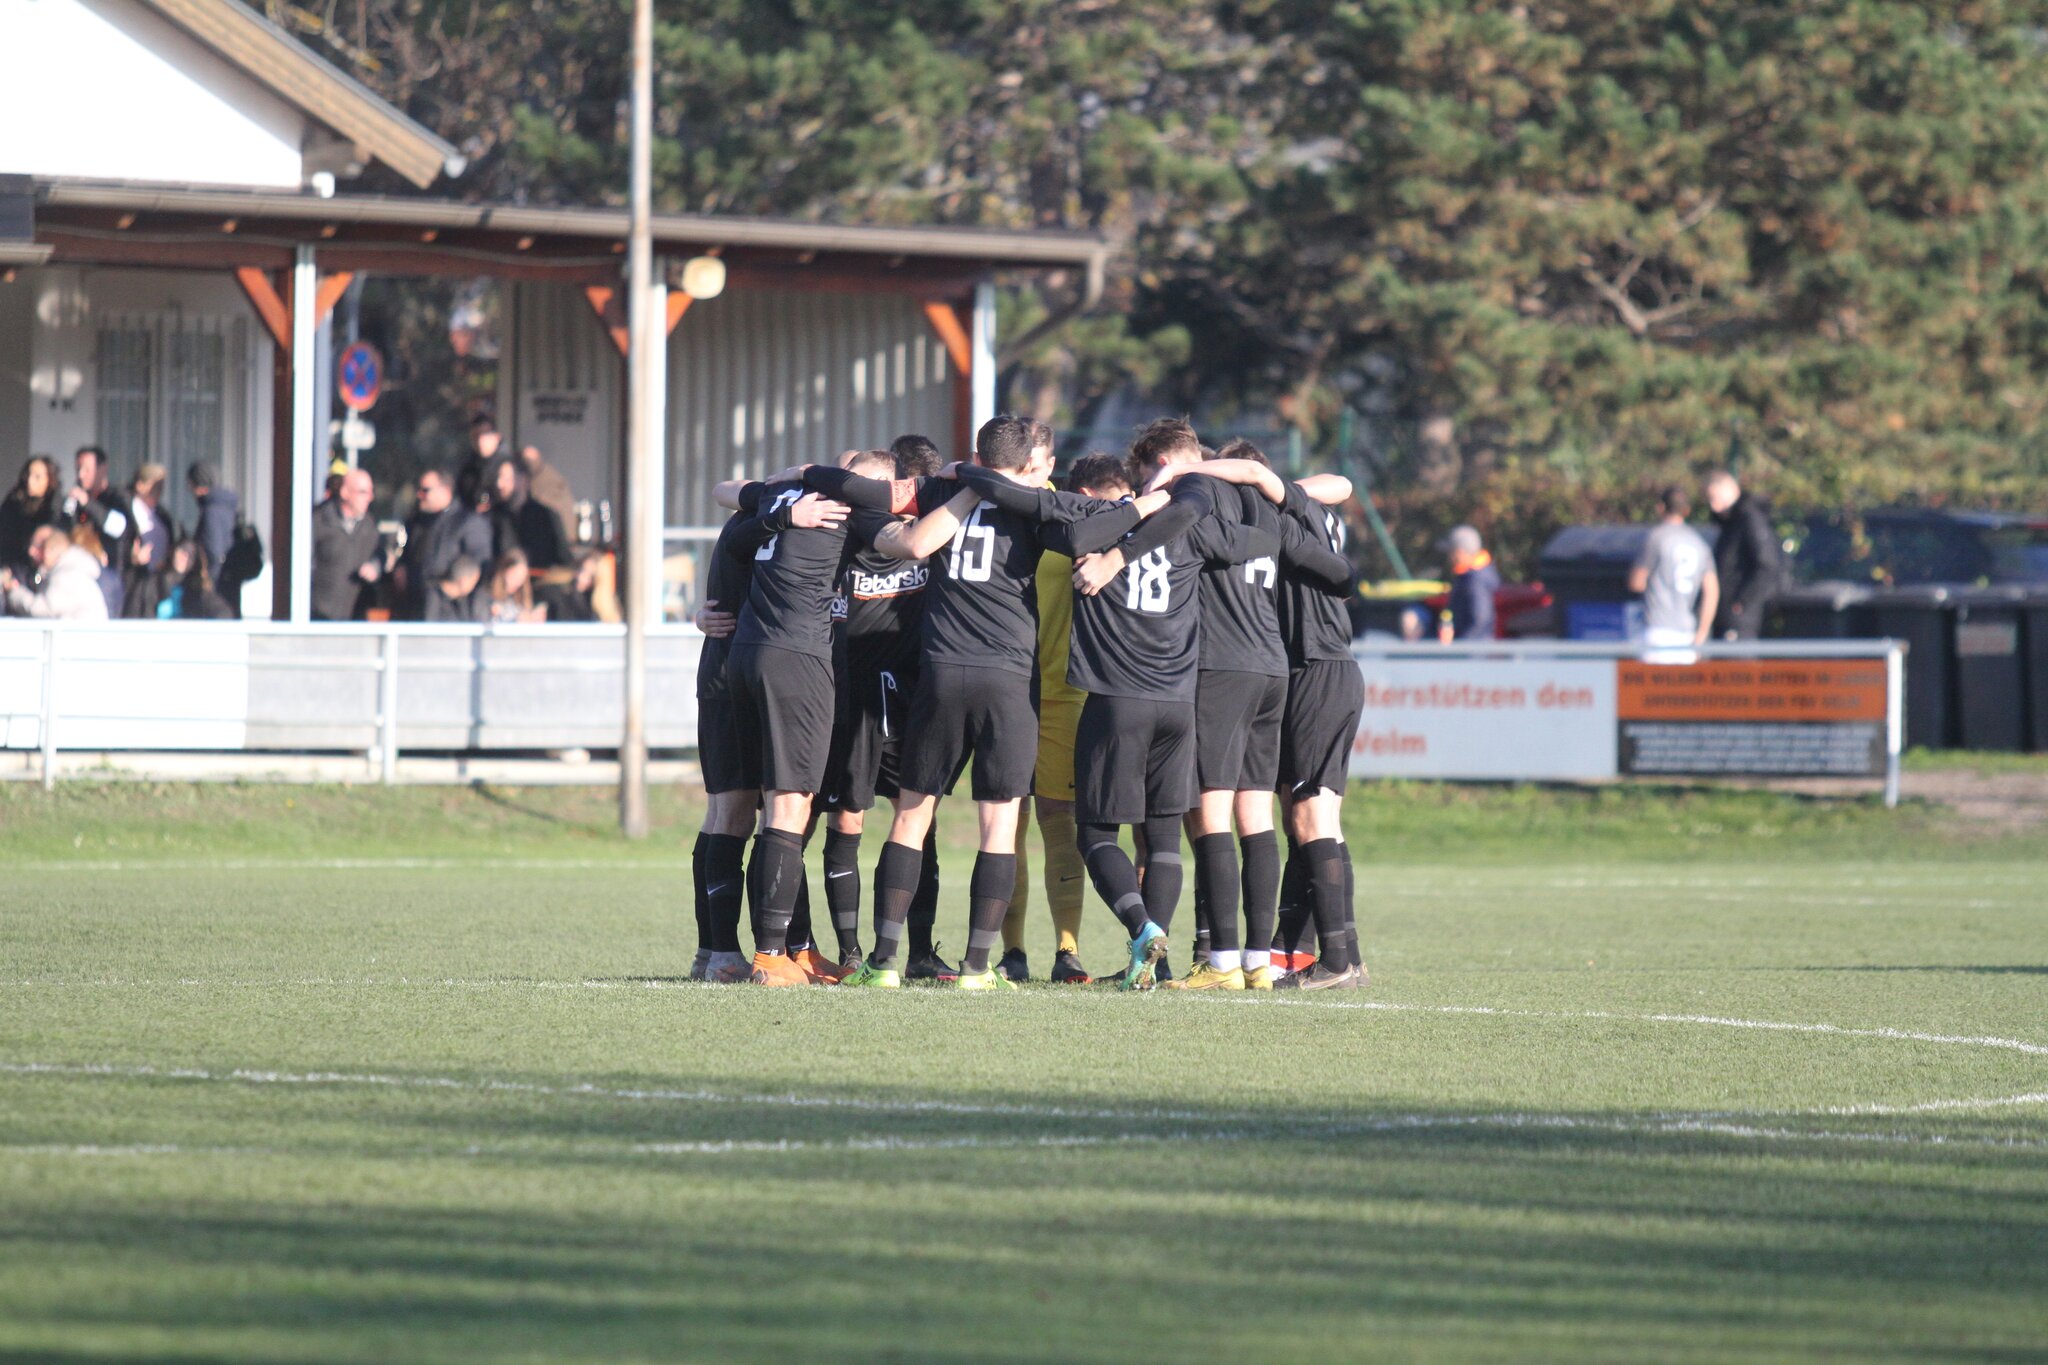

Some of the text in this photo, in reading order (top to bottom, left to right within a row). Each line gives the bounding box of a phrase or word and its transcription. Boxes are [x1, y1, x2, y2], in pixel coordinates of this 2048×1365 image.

[949, 500, 997, 581] 15
[1127, 545, 1172, 612] 18
[1365, 679, 1595, 708] terstützen den
